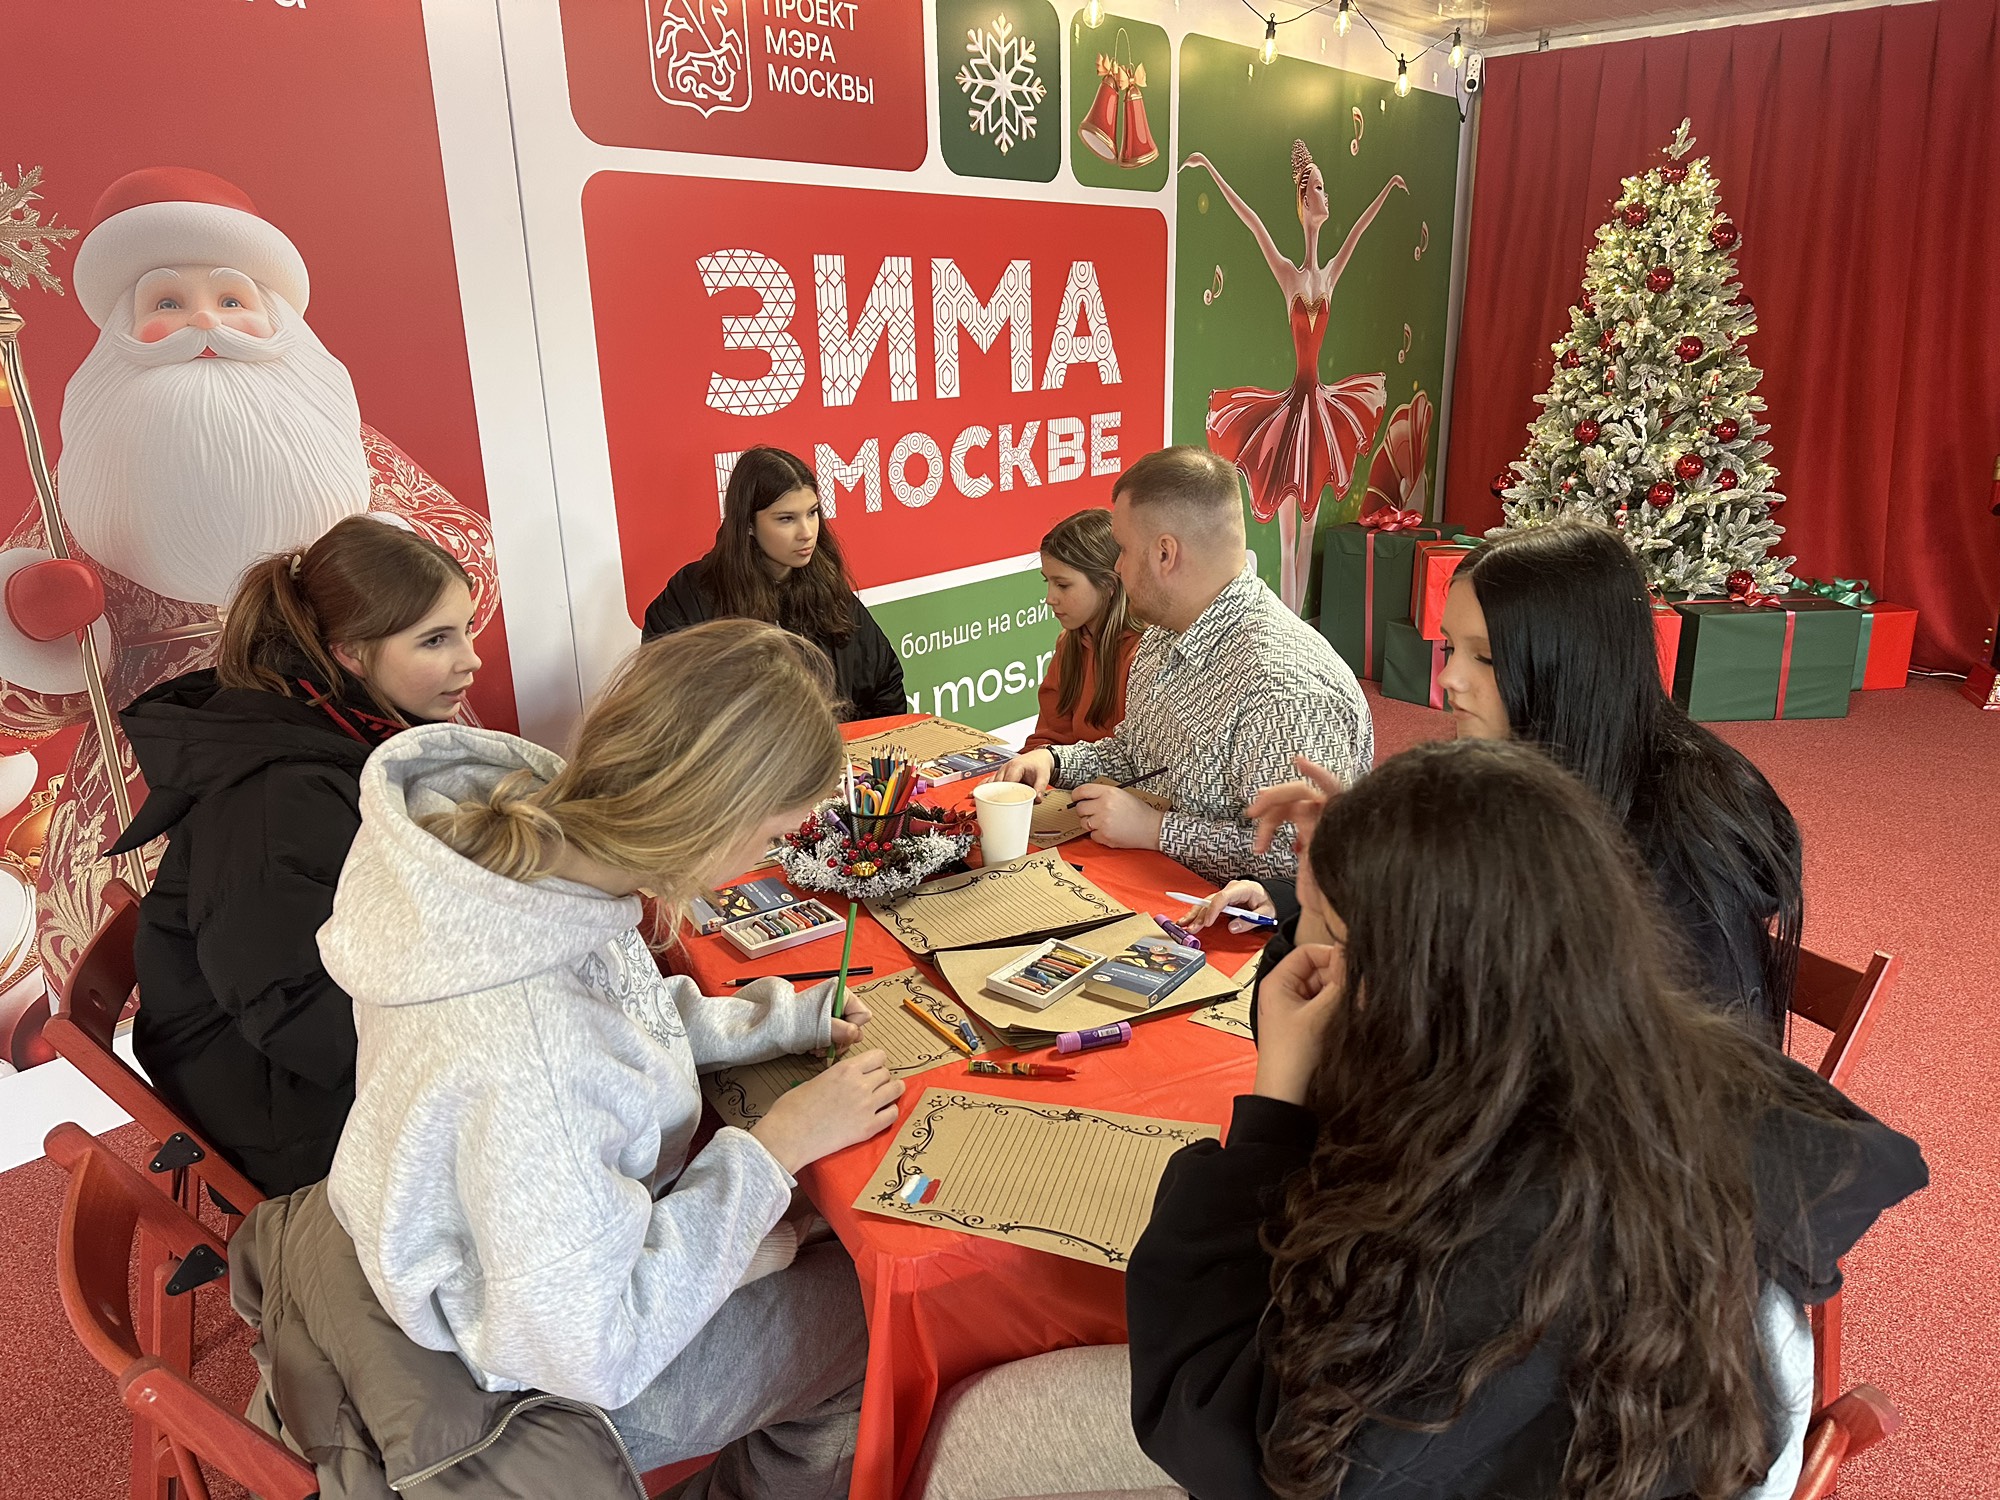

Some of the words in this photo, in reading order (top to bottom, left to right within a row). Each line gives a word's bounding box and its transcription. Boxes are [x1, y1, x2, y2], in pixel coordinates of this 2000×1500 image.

[762, 0, 859, 31] ПРОЕКТ
[764, 25, 837, 64] МЭРА
[767, 63, 874, 105] МОСКВЫ
[696, 248, 1123, 417] ЗИМА
[813, 411, 1122, 520] МОСКВЕ
[901, 621, 982, 659] больше
[988, 613, 1011, 636] на
[1016, 597, 1056, 628] сай
